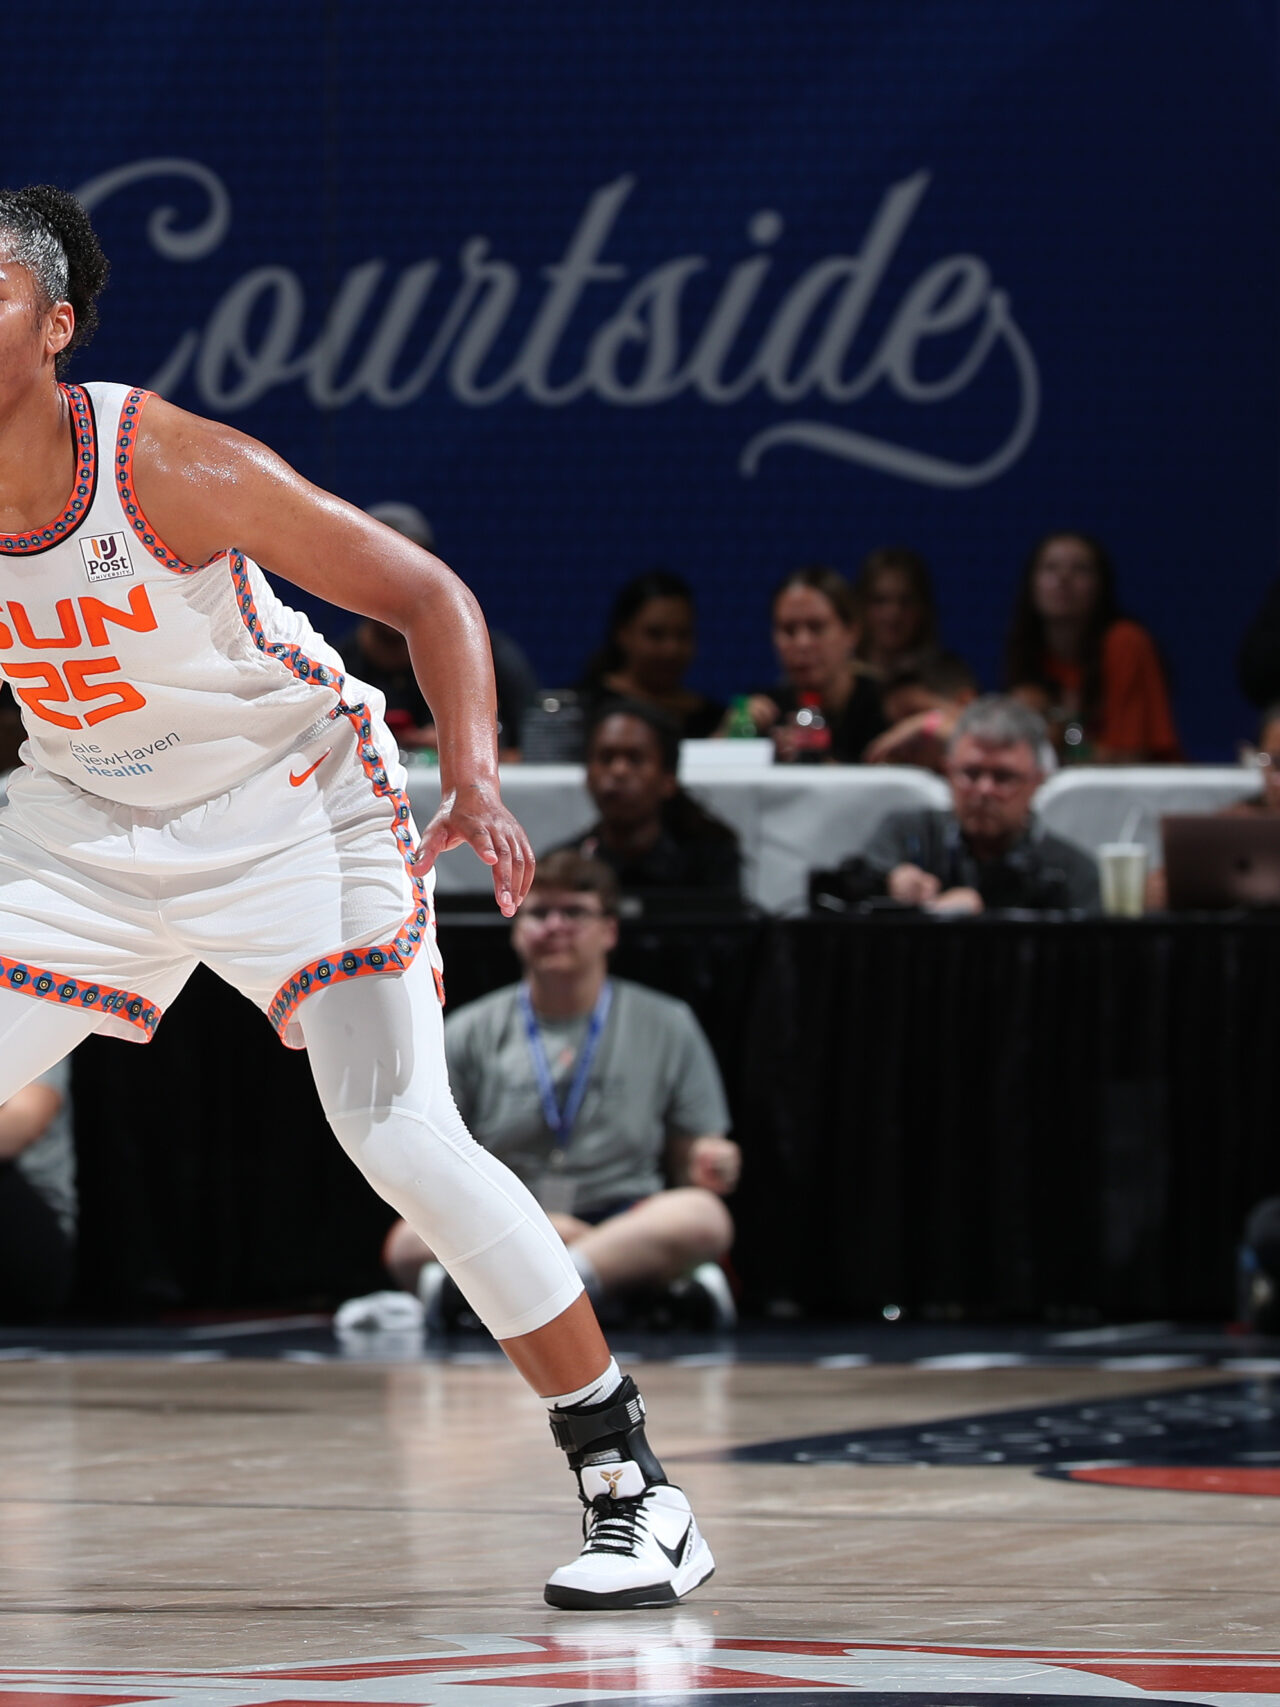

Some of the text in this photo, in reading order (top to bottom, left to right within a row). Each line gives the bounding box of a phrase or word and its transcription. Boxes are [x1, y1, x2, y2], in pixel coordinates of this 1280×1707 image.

[87, 556, 129, 575] Post
[0, 655, 147, 731] 25
[71, 731, 181, 766] NewHaven
[83, 762, 154, 778] Health
